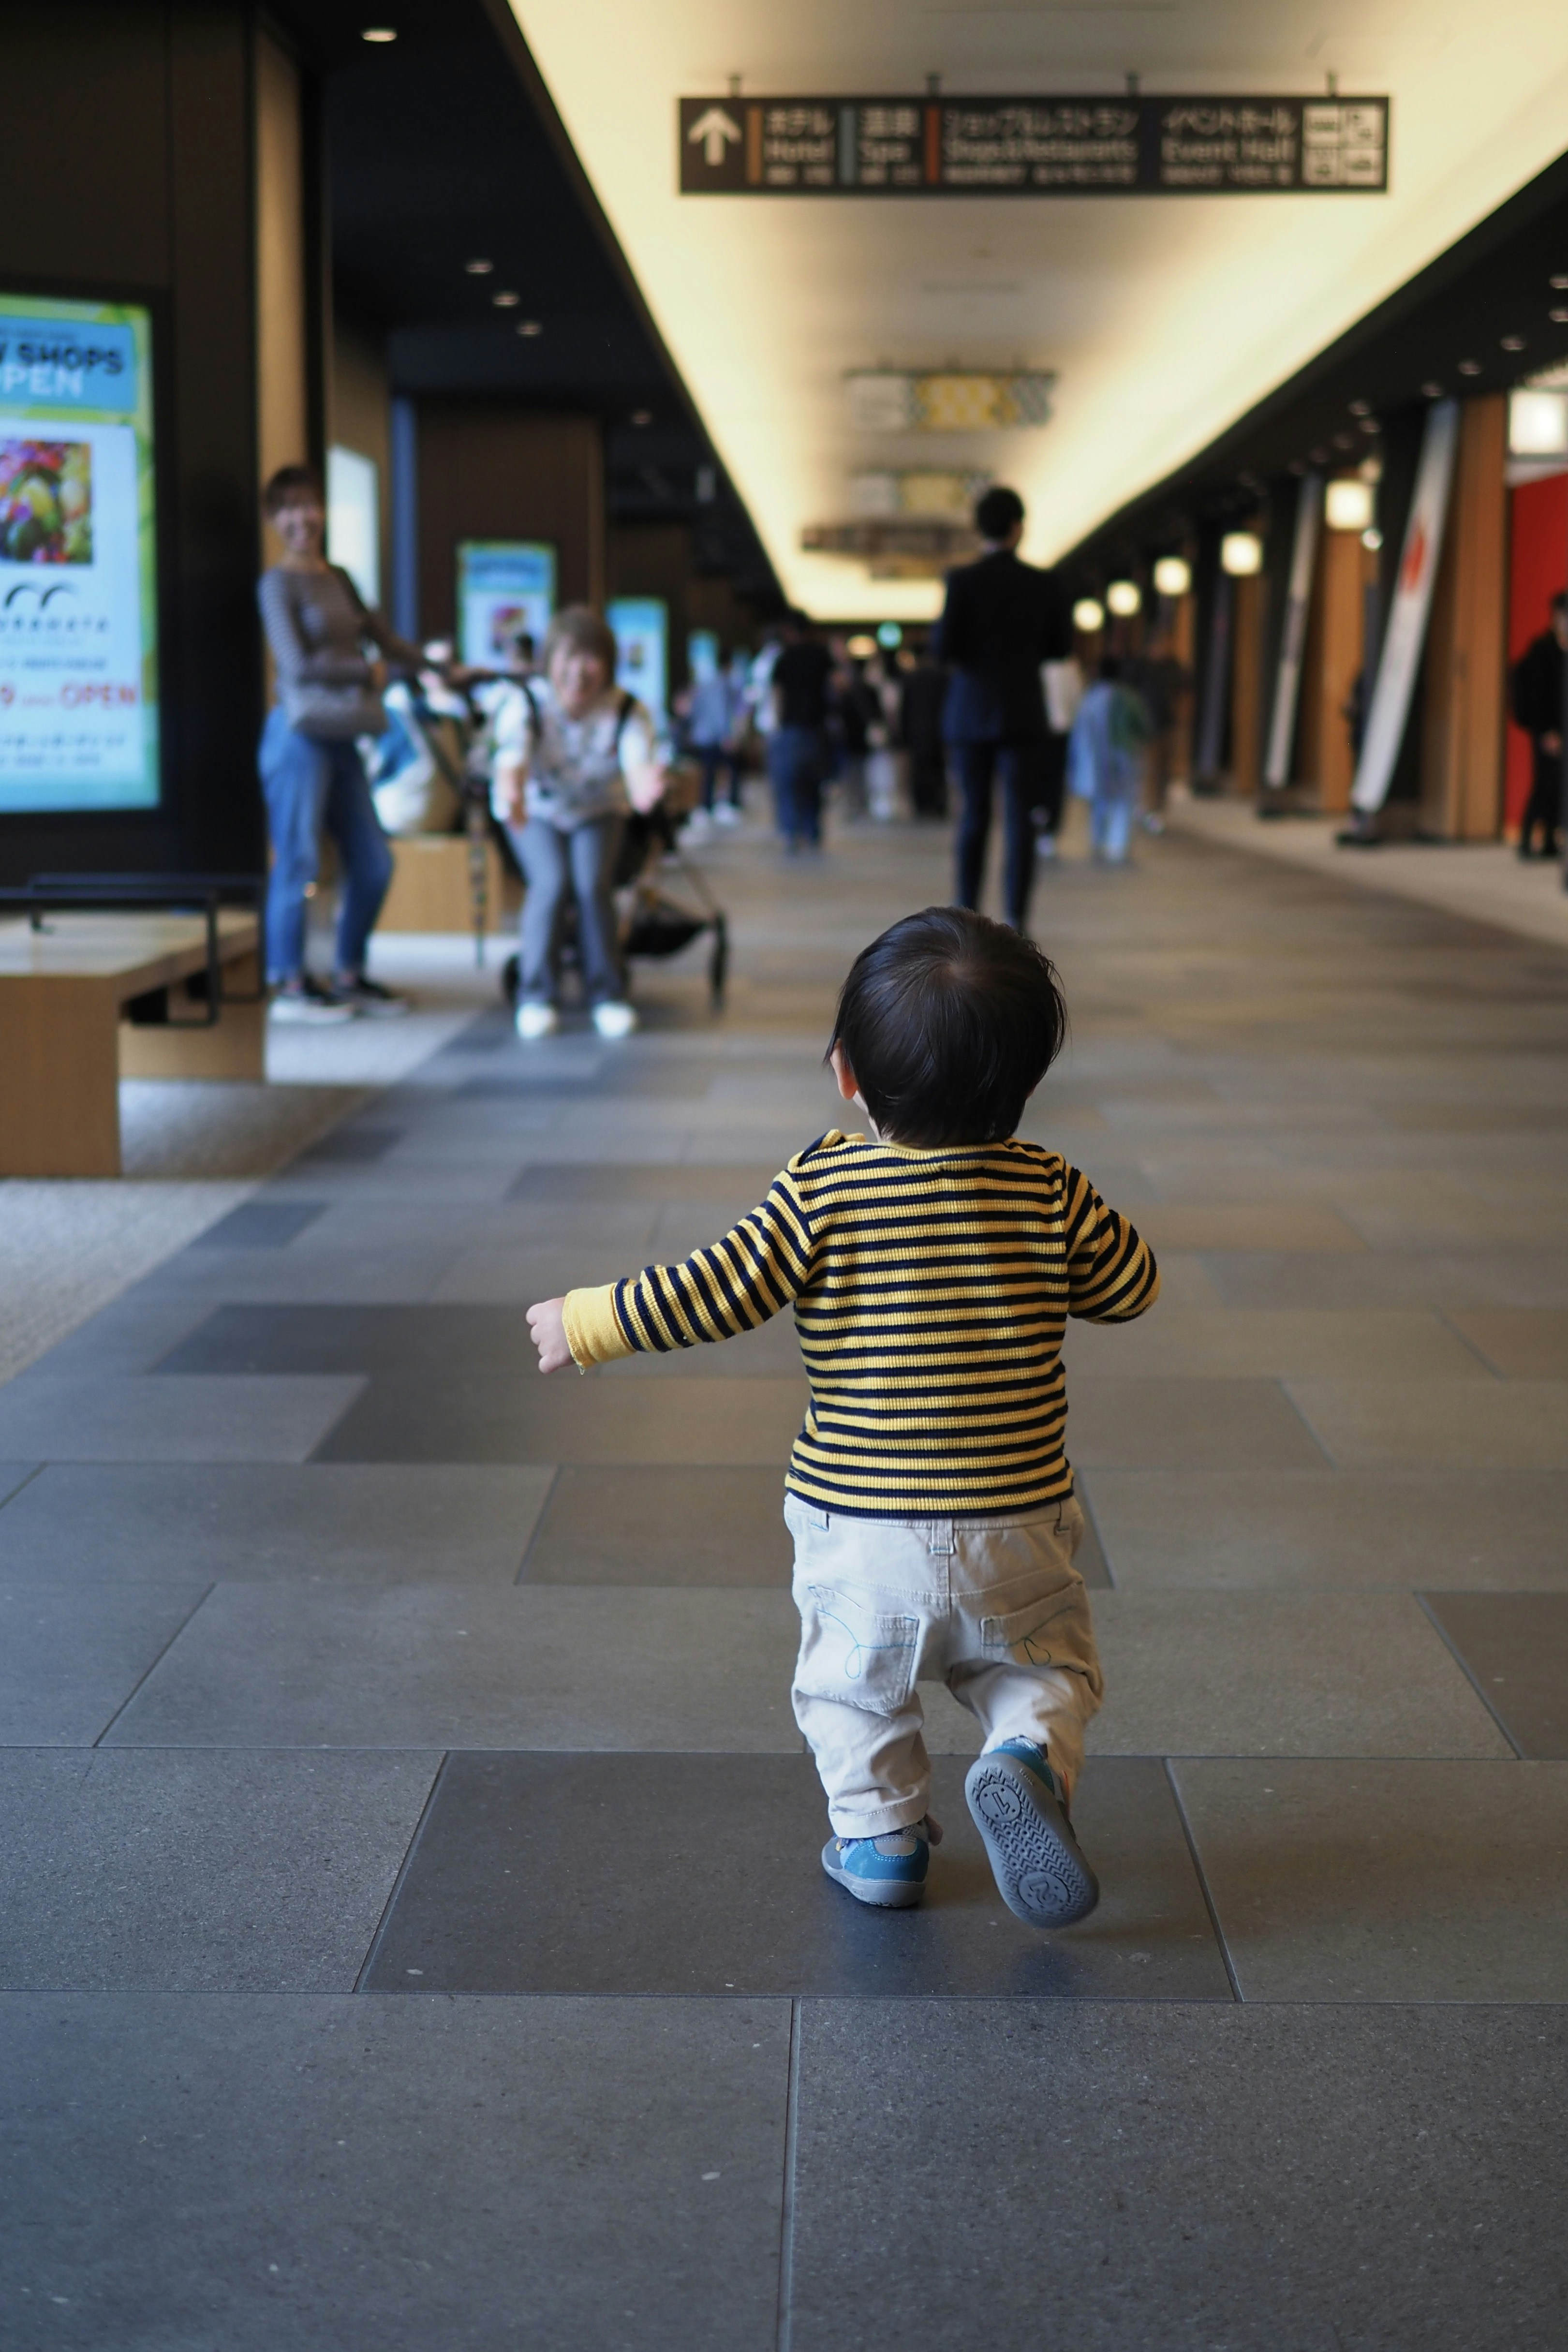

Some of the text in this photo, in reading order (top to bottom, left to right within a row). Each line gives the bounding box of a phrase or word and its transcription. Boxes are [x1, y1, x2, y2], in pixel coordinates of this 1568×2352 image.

[18, 341, 122, 376] SHOPS
[0, 364, 81, 398] PEN
[61, 681, 137, 710] OPEN
